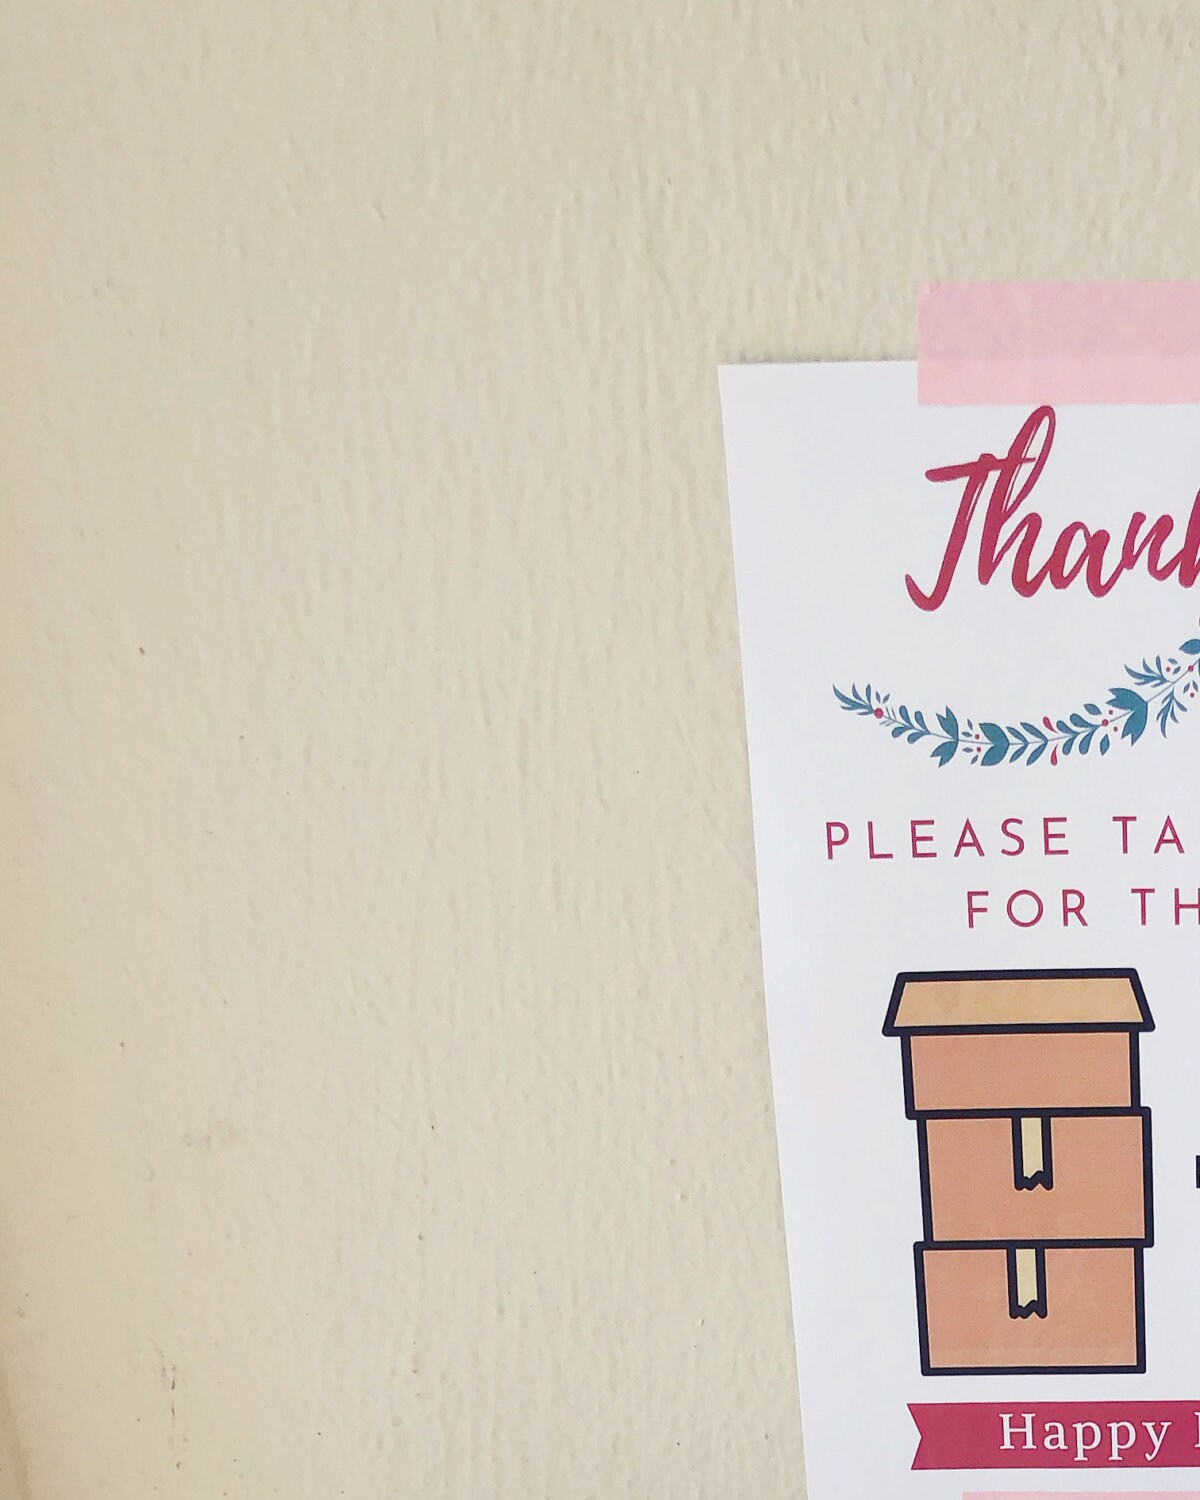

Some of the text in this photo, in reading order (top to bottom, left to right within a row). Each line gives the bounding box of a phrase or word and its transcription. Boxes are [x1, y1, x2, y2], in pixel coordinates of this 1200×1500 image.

[826, 817, 1070, 860] PLEASE
[967, 889, 1089, 929] FOR
[998, 1413, 1171, 1461] Happy
